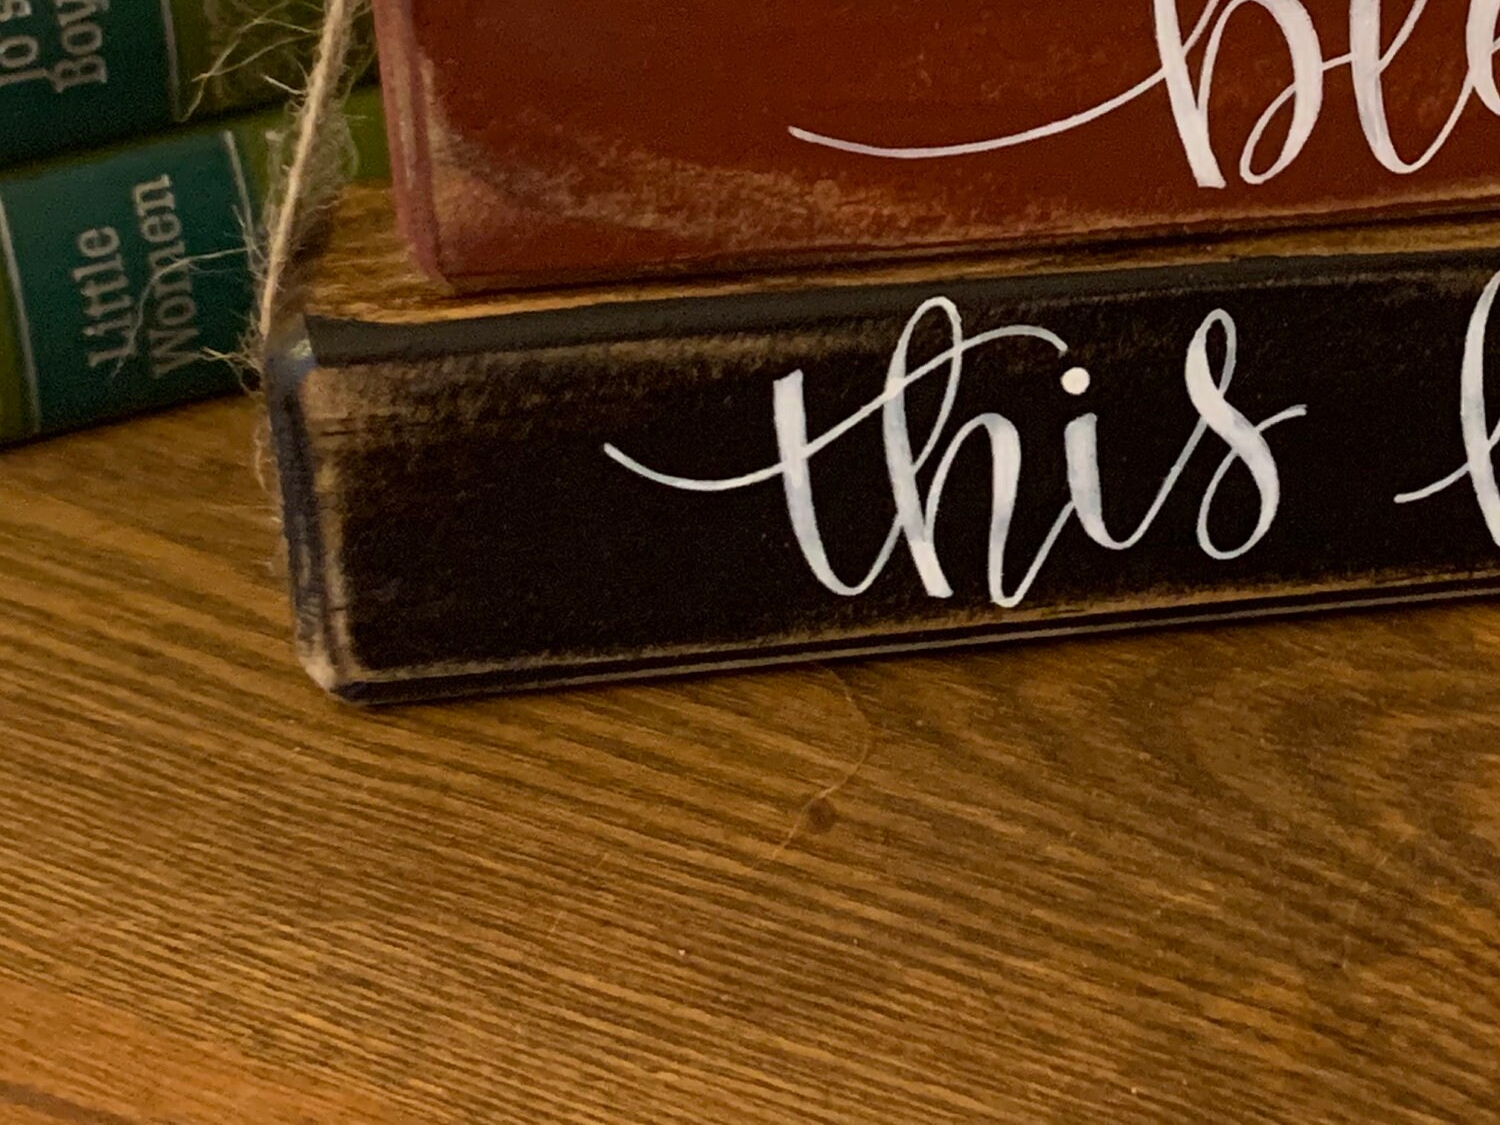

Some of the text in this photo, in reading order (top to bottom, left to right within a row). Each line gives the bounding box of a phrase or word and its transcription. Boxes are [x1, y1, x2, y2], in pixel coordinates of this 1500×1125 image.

[71, 225, 136, 368] Little
[131, 173, 200, 379] Women
[603, 296, 1307, 608] this
